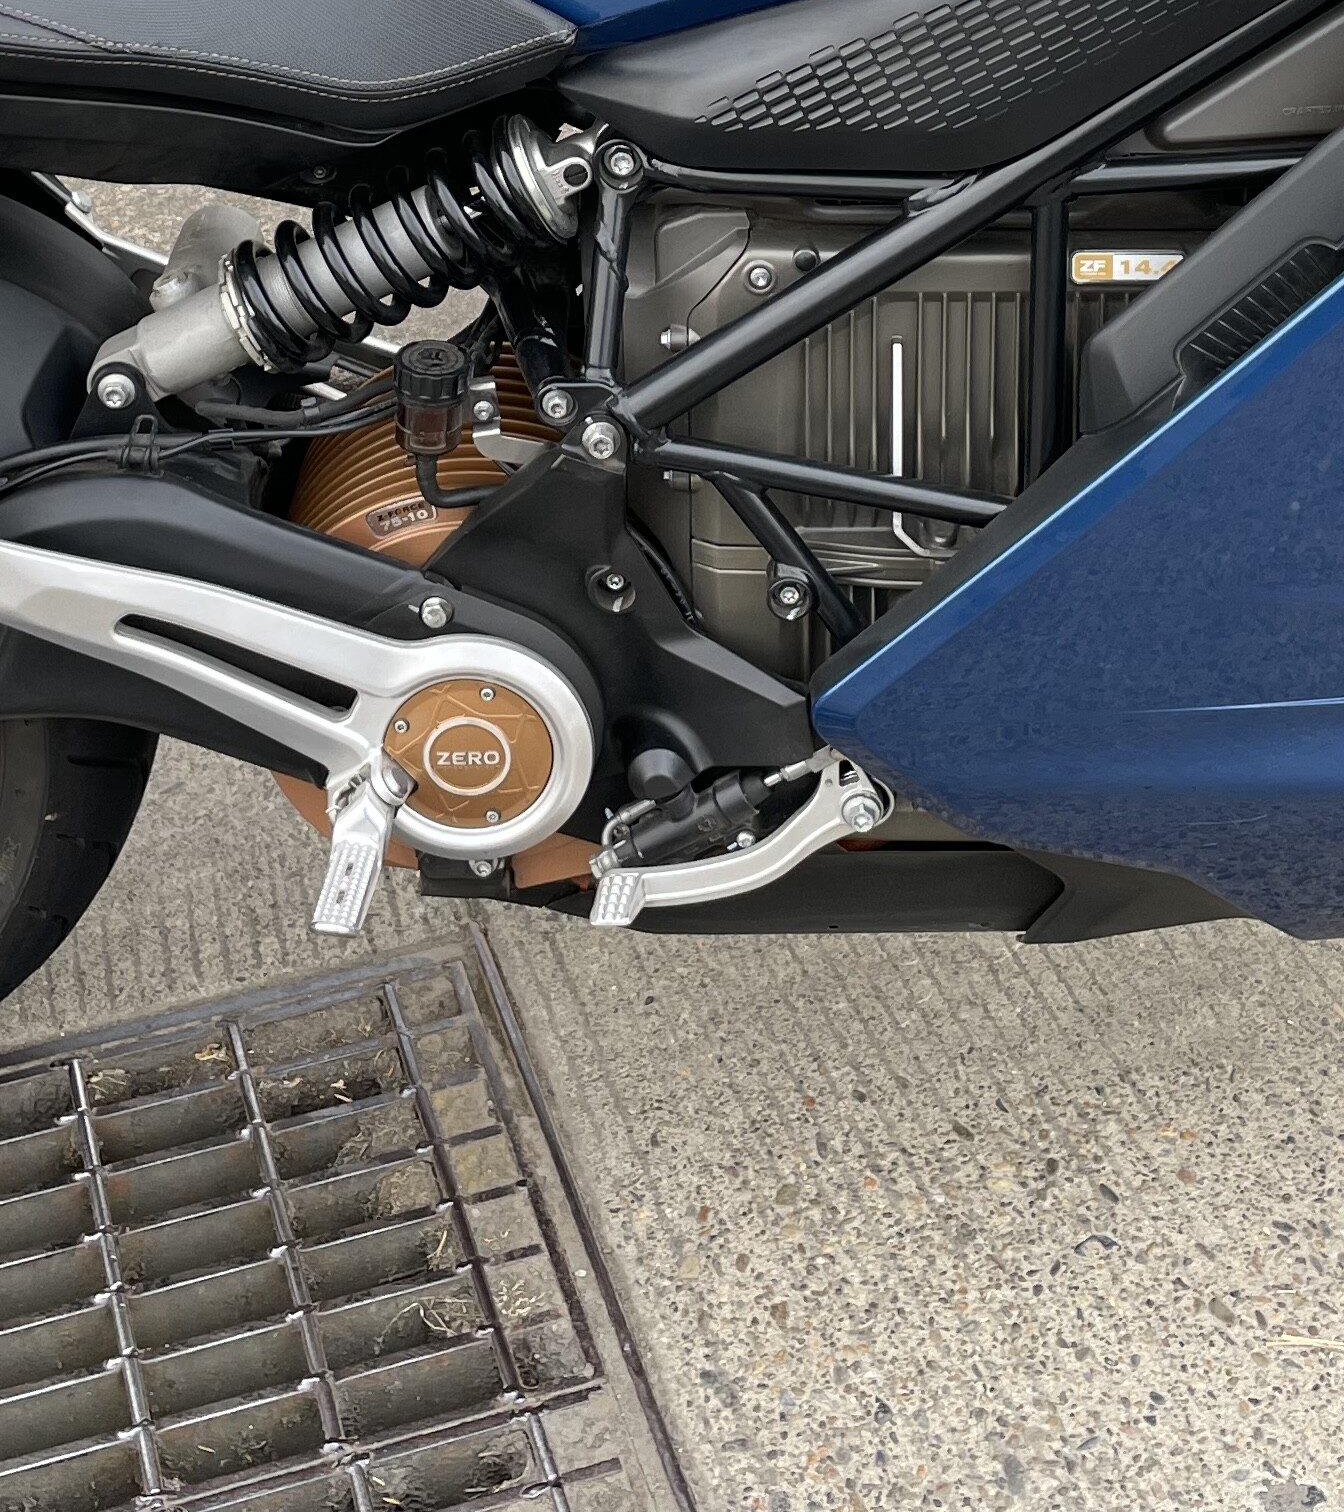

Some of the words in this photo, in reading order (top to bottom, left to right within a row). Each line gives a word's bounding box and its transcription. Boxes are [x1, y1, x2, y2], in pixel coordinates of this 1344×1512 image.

[1079, 259, 1107, 272] ZF
[377, 501, 426, 522] Z-FORCE
[379, 509, 429, 532] 75-10
[436, 750, 501, 766] ZERO
